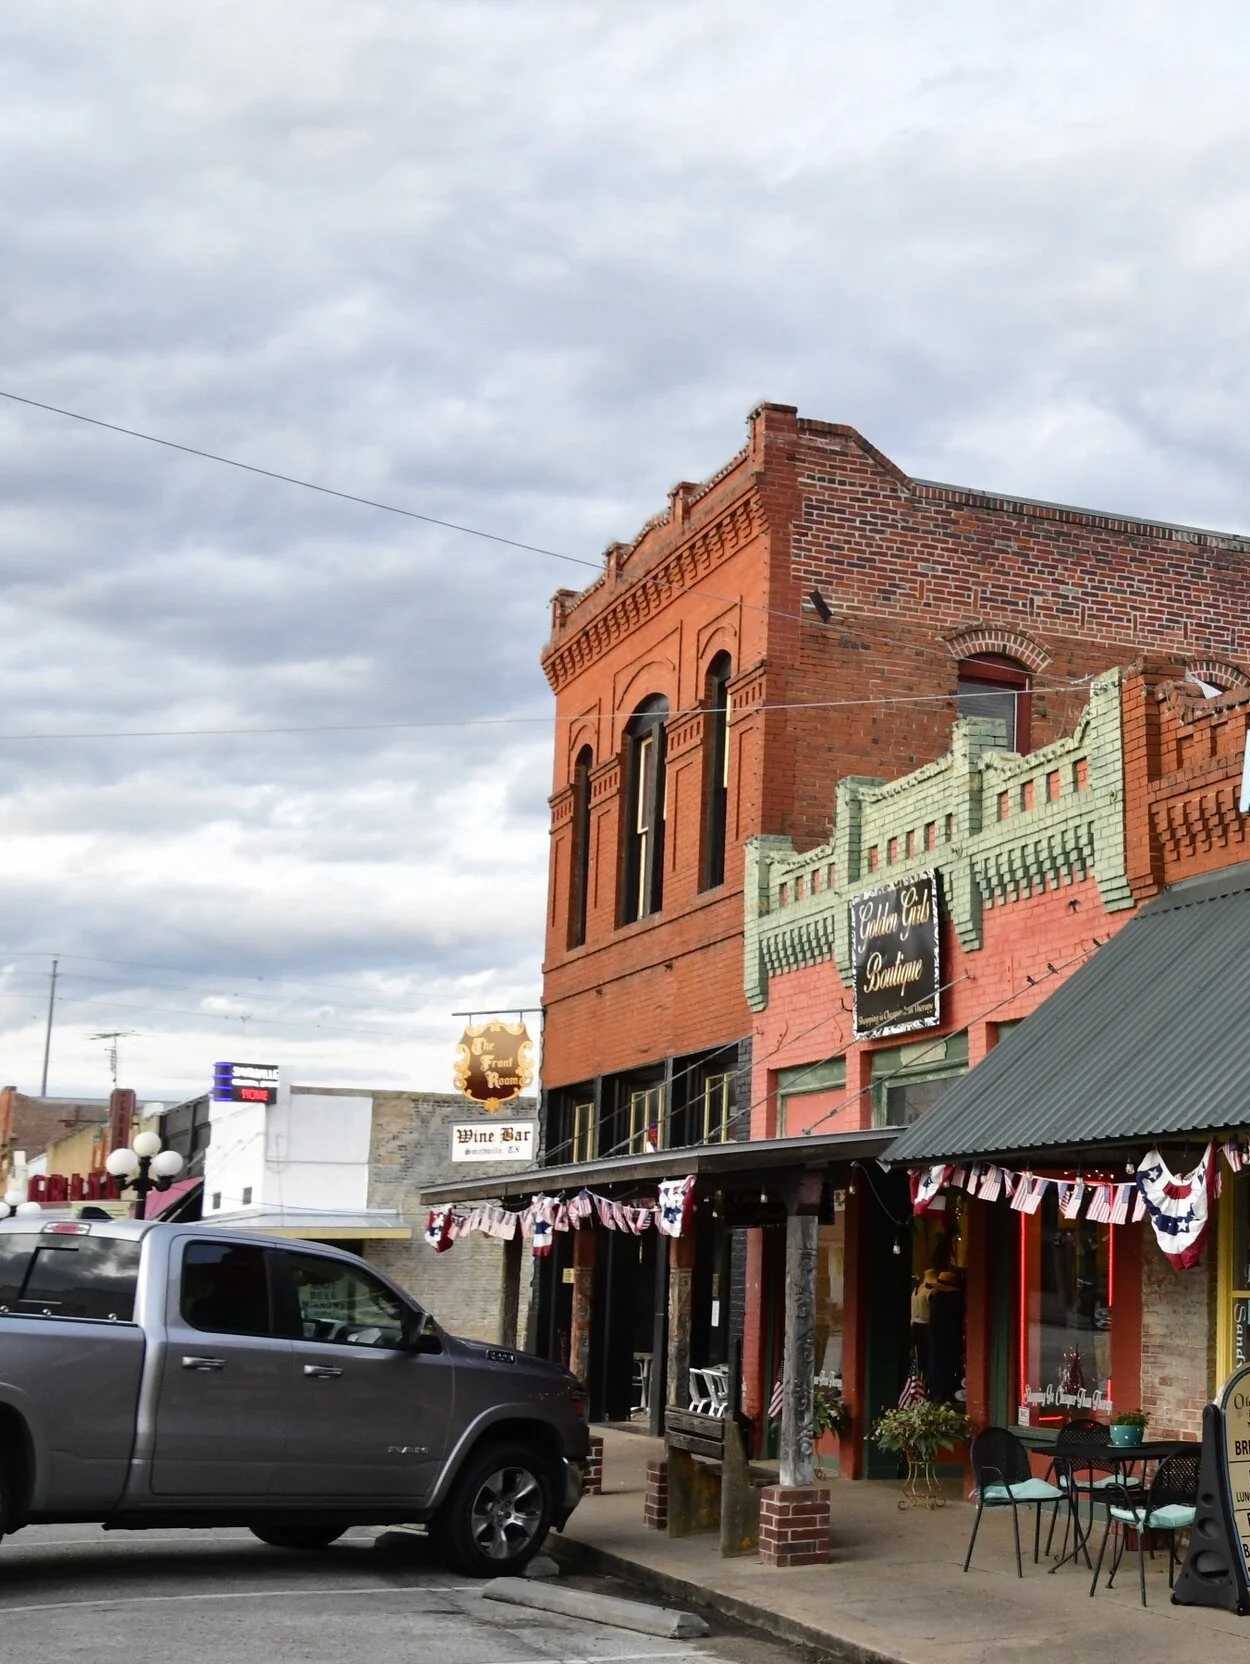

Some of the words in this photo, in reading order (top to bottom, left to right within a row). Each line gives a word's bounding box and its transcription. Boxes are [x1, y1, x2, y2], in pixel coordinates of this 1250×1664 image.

[858, 900, 899, 953] Golden
[899, 887, 930, 941] Girls
[863, 951, 923, 997] Boutique
[471, 1037, 495, 1056] The
[480, 1055, 513, 1072] Front
[485, 1071, 519, 1088] Room
[456, 1128, 494, 1143] Wine
[500, 1127, 531, 1143] Bar
